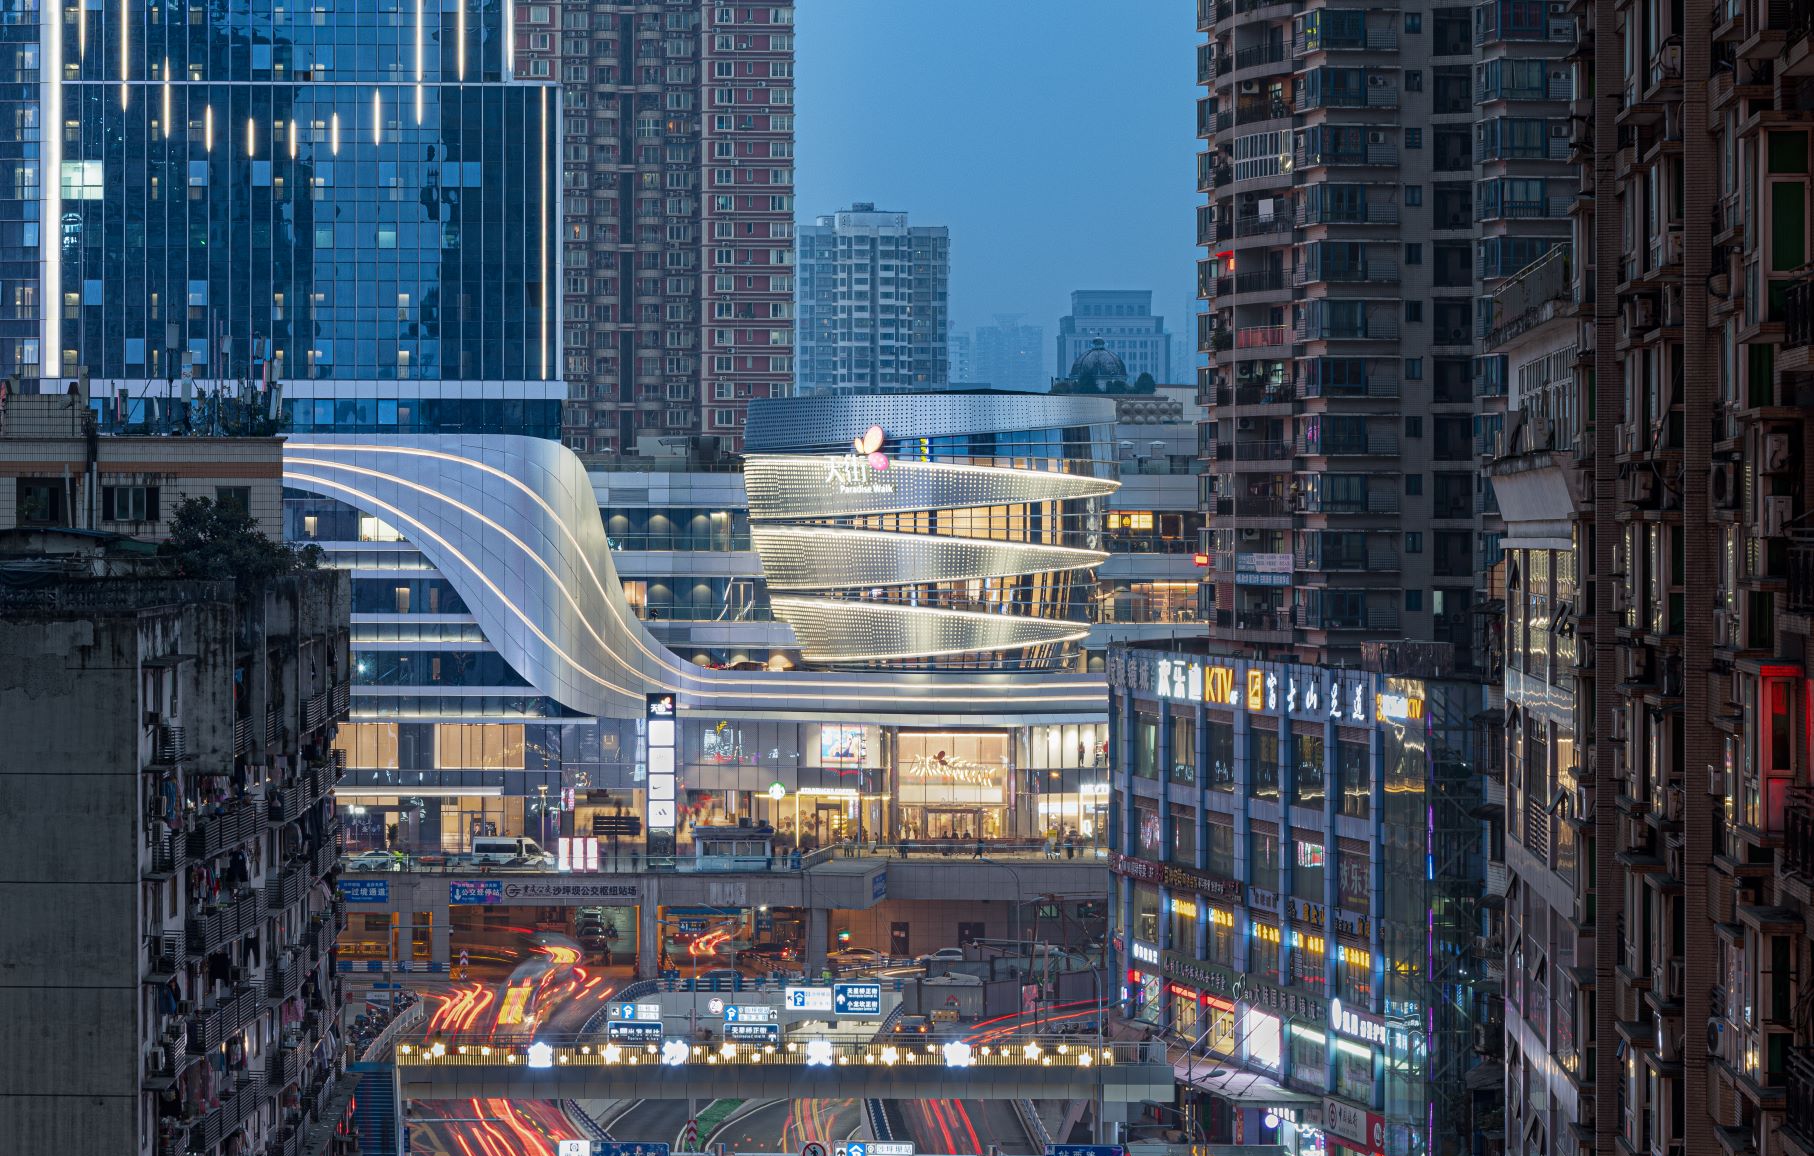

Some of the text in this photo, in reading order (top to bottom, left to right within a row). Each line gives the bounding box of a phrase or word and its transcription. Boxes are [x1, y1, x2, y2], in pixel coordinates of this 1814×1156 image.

[840, 484, 894, 493] Paradise Walk
[1205, 666, 1233, 704] KTV
[1266, 672, 1365, 720] 富士山足道
[553, 886, 637, 896] 沙坪坝公交枢纽站场
